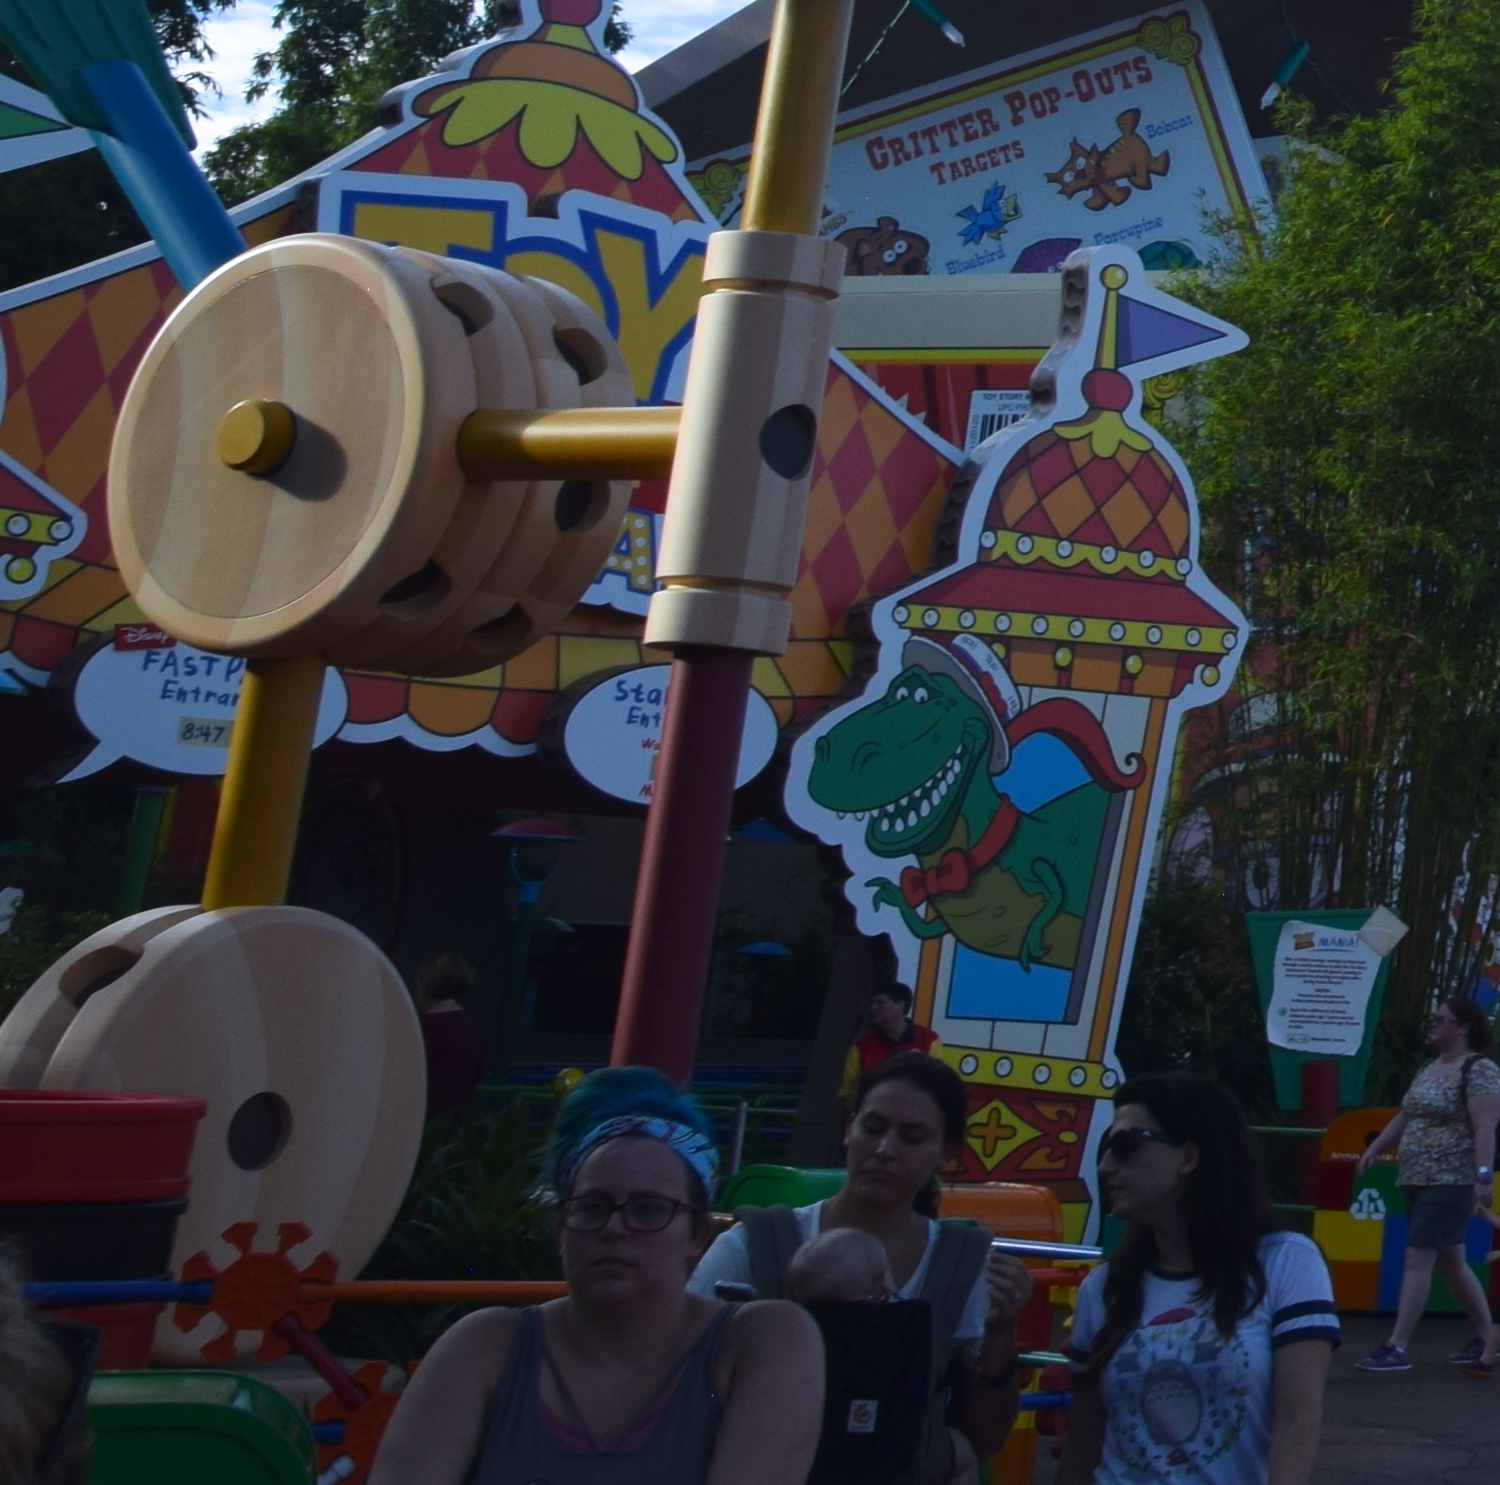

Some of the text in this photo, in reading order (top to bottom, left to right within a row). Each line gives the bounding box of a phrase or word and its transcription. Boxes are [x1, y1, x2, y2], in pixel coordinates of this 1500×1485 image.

[865, 55, 1153, 171] CRITTER POP-OUTS
[1144, 114, 1194, 140] Bobcat
[929, 140, 1025, 185] TARGETS
[1092, 215, 1163, 246] Porcupine
[945, 245, 1007, 276] Bluebird
[143, 650, 245, 684] FASTP
[182, 723, 226, 743] 8:47
